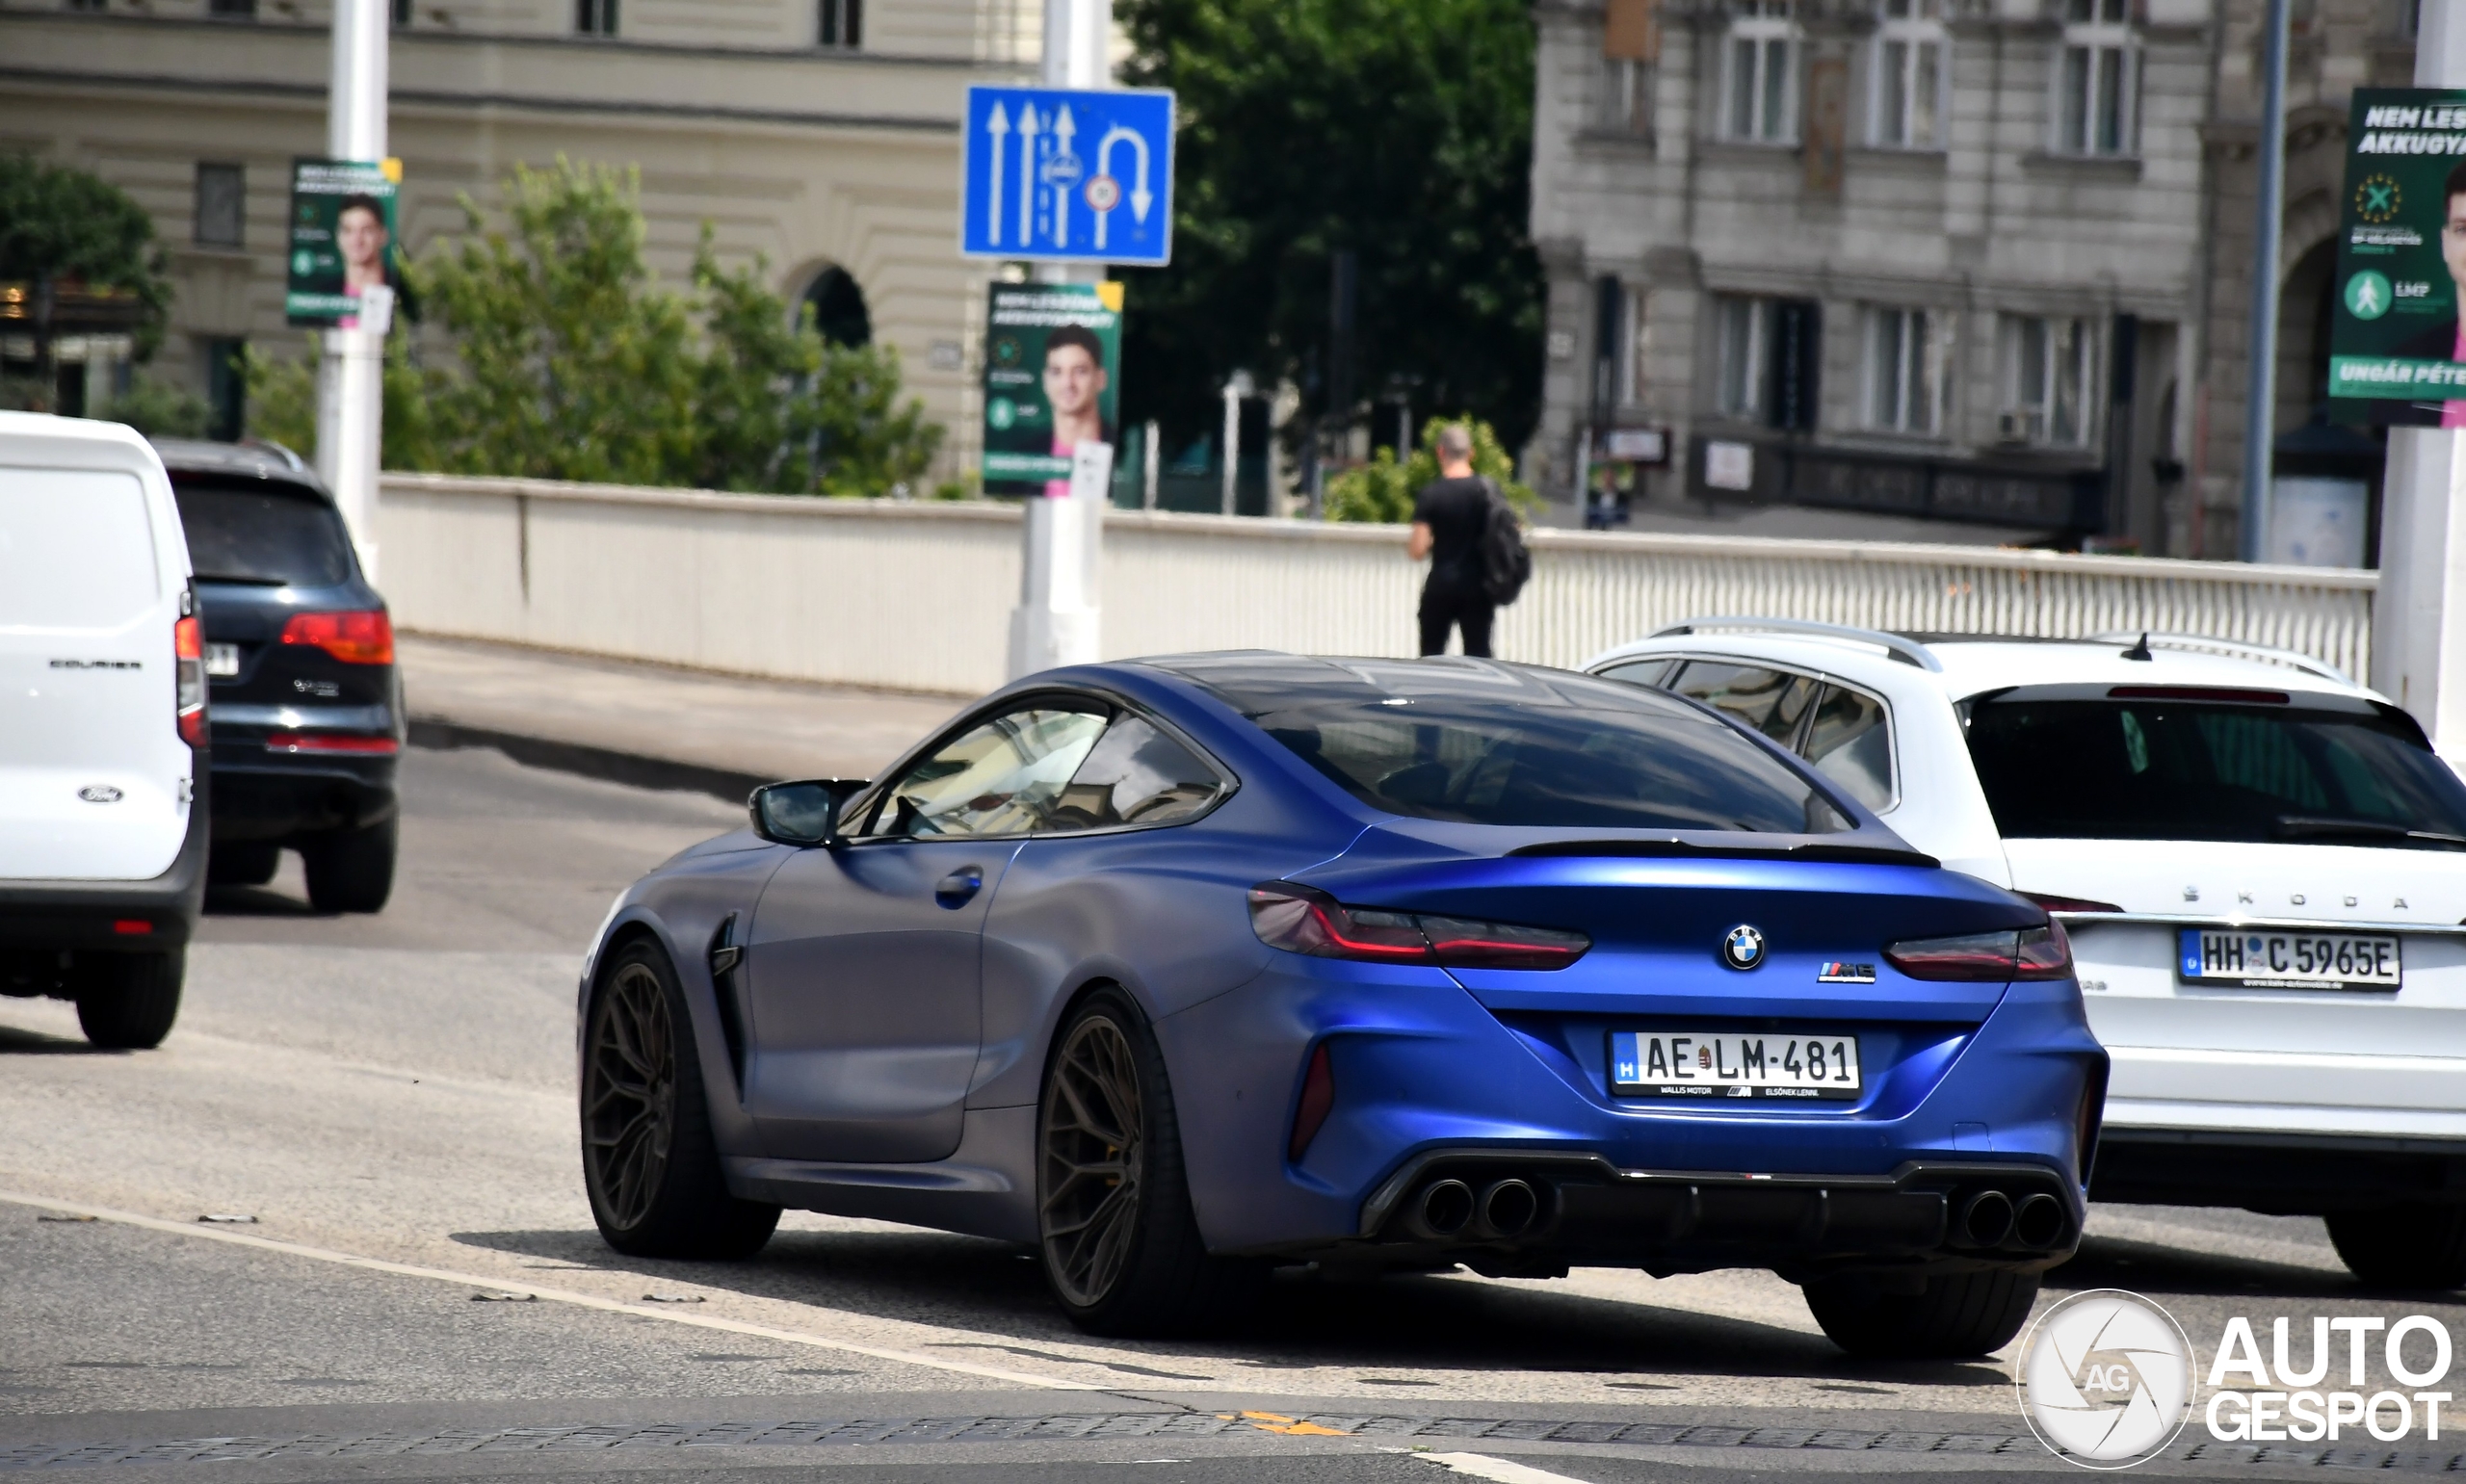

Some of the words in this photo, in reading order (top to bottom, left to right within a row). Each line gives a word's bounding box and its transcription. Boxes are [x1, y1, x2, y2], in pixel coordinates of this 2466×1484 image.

[2365, 105, 2421, 128] NEM
[2421, 106, 2466, 129] LES
[2339, 360, 2412, 382] UNGÁR
[50, 660, 143, 669] COURIER
[83, 786, 119, 801] Ford
[1729, 927, 1763, 942] BMW
[2203, 935, 2244, 972] HH
[2269, 938, 2287, 973] C
[2295, 940, 2394, 977] 5965E
[1647, 1037, 1695, 1079] AE
[1715, 1038, 1850, 1081] LM-481
[1620, 1062, 1634, 1078] H
